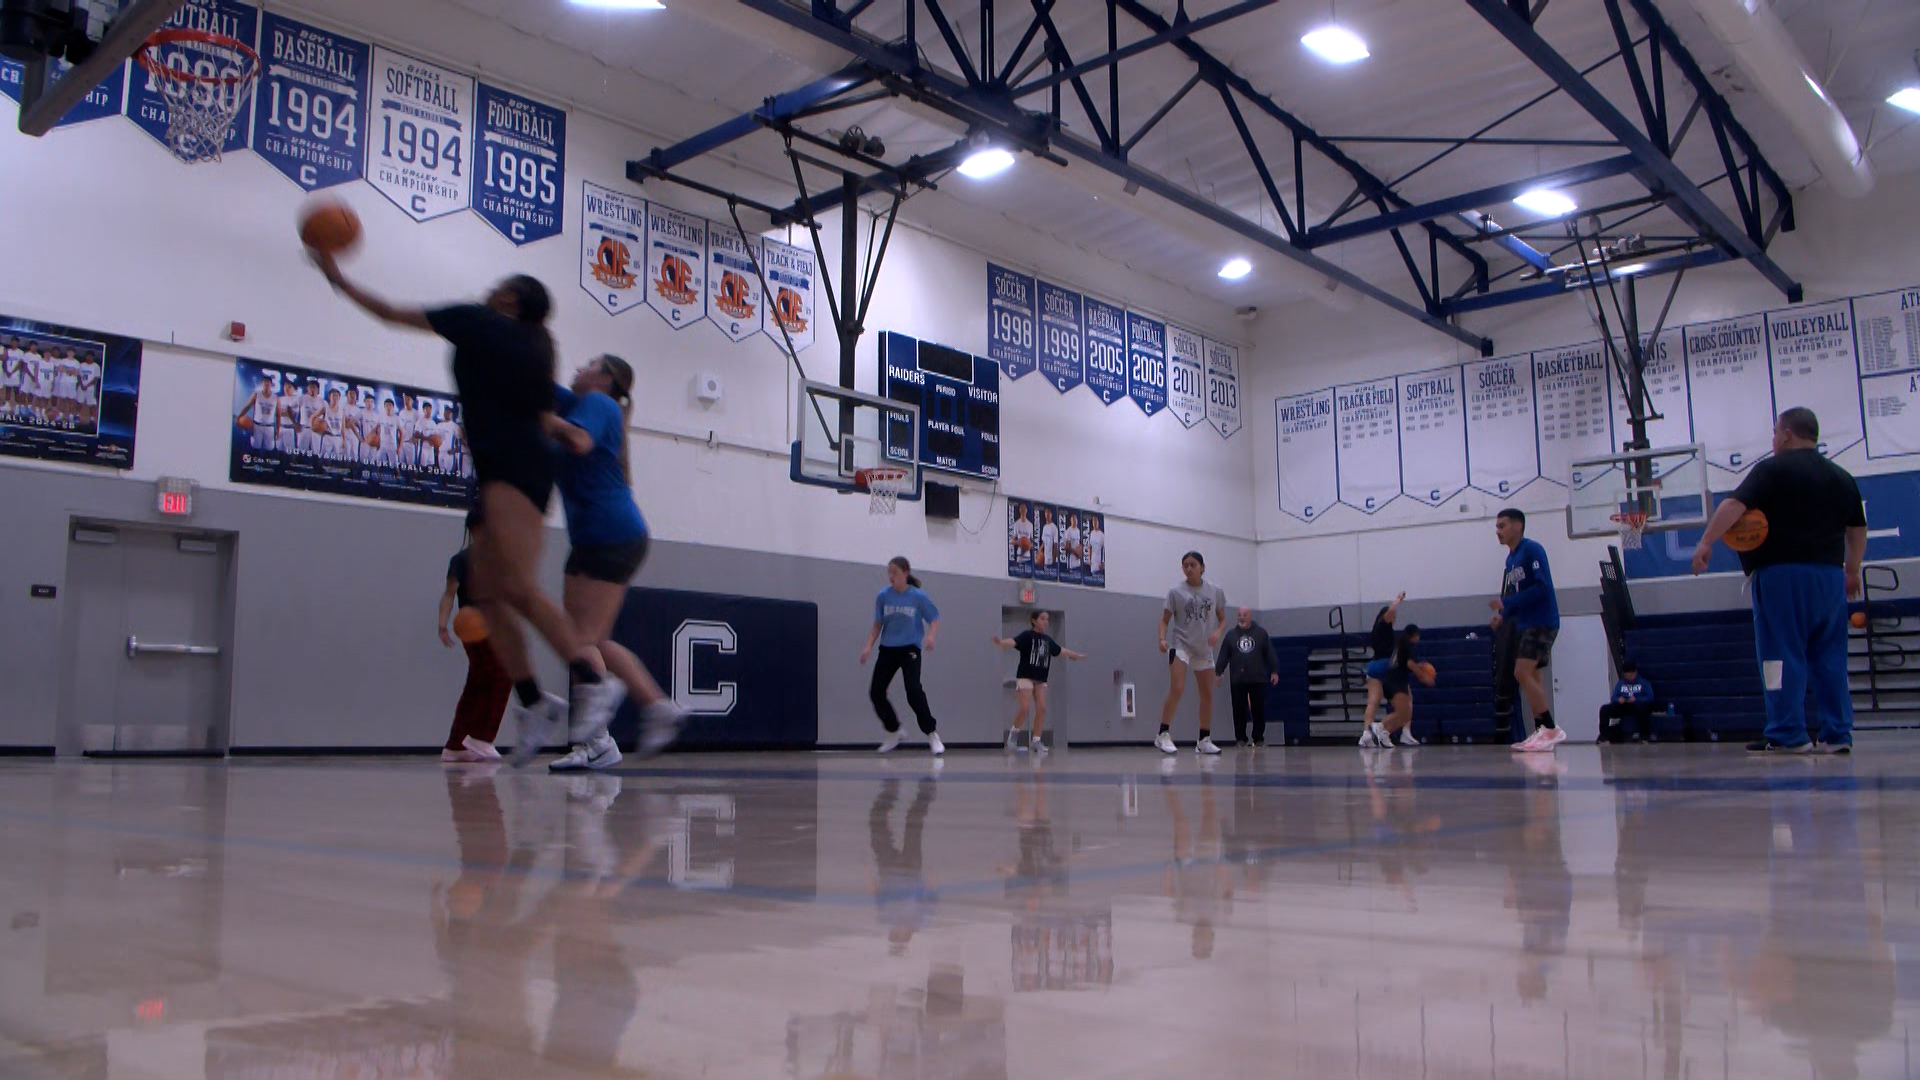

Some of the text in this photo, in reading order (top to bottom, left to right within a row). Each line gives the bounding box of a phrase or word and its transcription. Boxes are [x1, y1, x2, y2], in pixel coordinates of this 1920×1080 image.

[273, 31, 356, 82] BASEBALL
[386, 67, 459, 115] SOFTBALL
[269, 81, 357, 147] 1994
[487, 100, 554, 147] FOOTBALL
[265, 138, 353, 171] CHAMPIONSHIP
[382, 115, 462, 177] 1994
[300, 164, 317, 186] C
[379, 170, 458, 200] CHAMPIONSHIP
[484, 145, 556, 204] 1995
[411, 194, 426, 213] C
[483, 198, 554, 227] CHAMPIONSHIP
[586, 194, 642, 228] WRESTLING
[511, 221, 525, 240] C
[651, 214, 703, 245] WRESTLING
[711, 232, 733, 251] TRACK
[767, 249, 789, 268] TRACK
[608, 293, 618, 306] C
[995, 276, 1027, 304] SOCCER
[672, 308, 681, 321] C
[1044, 292, 1074, 319] SOCCER
[731, 322, 739, 335] C
[993, 309, 1032, 349] 1998
[1088, 308, 1121, 334] BASEBALL
[1772, 312, 1849, 340] VOLLEYBALL
[1044, 325, 1080, 363] 1999
[1690, 326, 1761, 354] CROSS COUNTRY
[1778, 338, 1843, 355] CHAMPIONSHIP
[1090, 340, 1123, 375] 2005
[1537, 352, 1603, 379] BASKETBALL
[889, 364, 925, 385] RAIDERS
[1008, 364, 1017, 377] C
[1132, 353, 1164, 388] 2006
[1173, 366, 1201, 398] 2011
[1479, 367, 1516, 389] SOCCER
[968, 386, 998, 404] VISITOR
[1058, 377, 1066, 390] C
[1210, 378, 1237, 409] 2013
[1406, 377, 1455, 401] SOFTBALL
[1103, 390, 1110, 403] C
[1145, 401, 1152, 414] C
[1338, 391, 1364, 412] TRACK
[1373, 387, 1394, 405] FIELD
[890, 411, 910, 423] FOULS
[1184, 412, 1191, 424] C
[1281, 399, 1330, 423] WRESTLING
[928, 419, 965, 436] PLAYER FOUL
[1221, 422, 1228, 434] C
[936, 455, 957, 467] MATCH
[1730, 452, 1741, 466] C
[1430, 490, 1440, 501] C
[1499, 480, 1509, 492] C
[162, 492, 186, 514] EXIT
[1304, 506, 1313, 517] C
[1365, 497, 1375, 508] C
[672, 618, 737, 716] C
